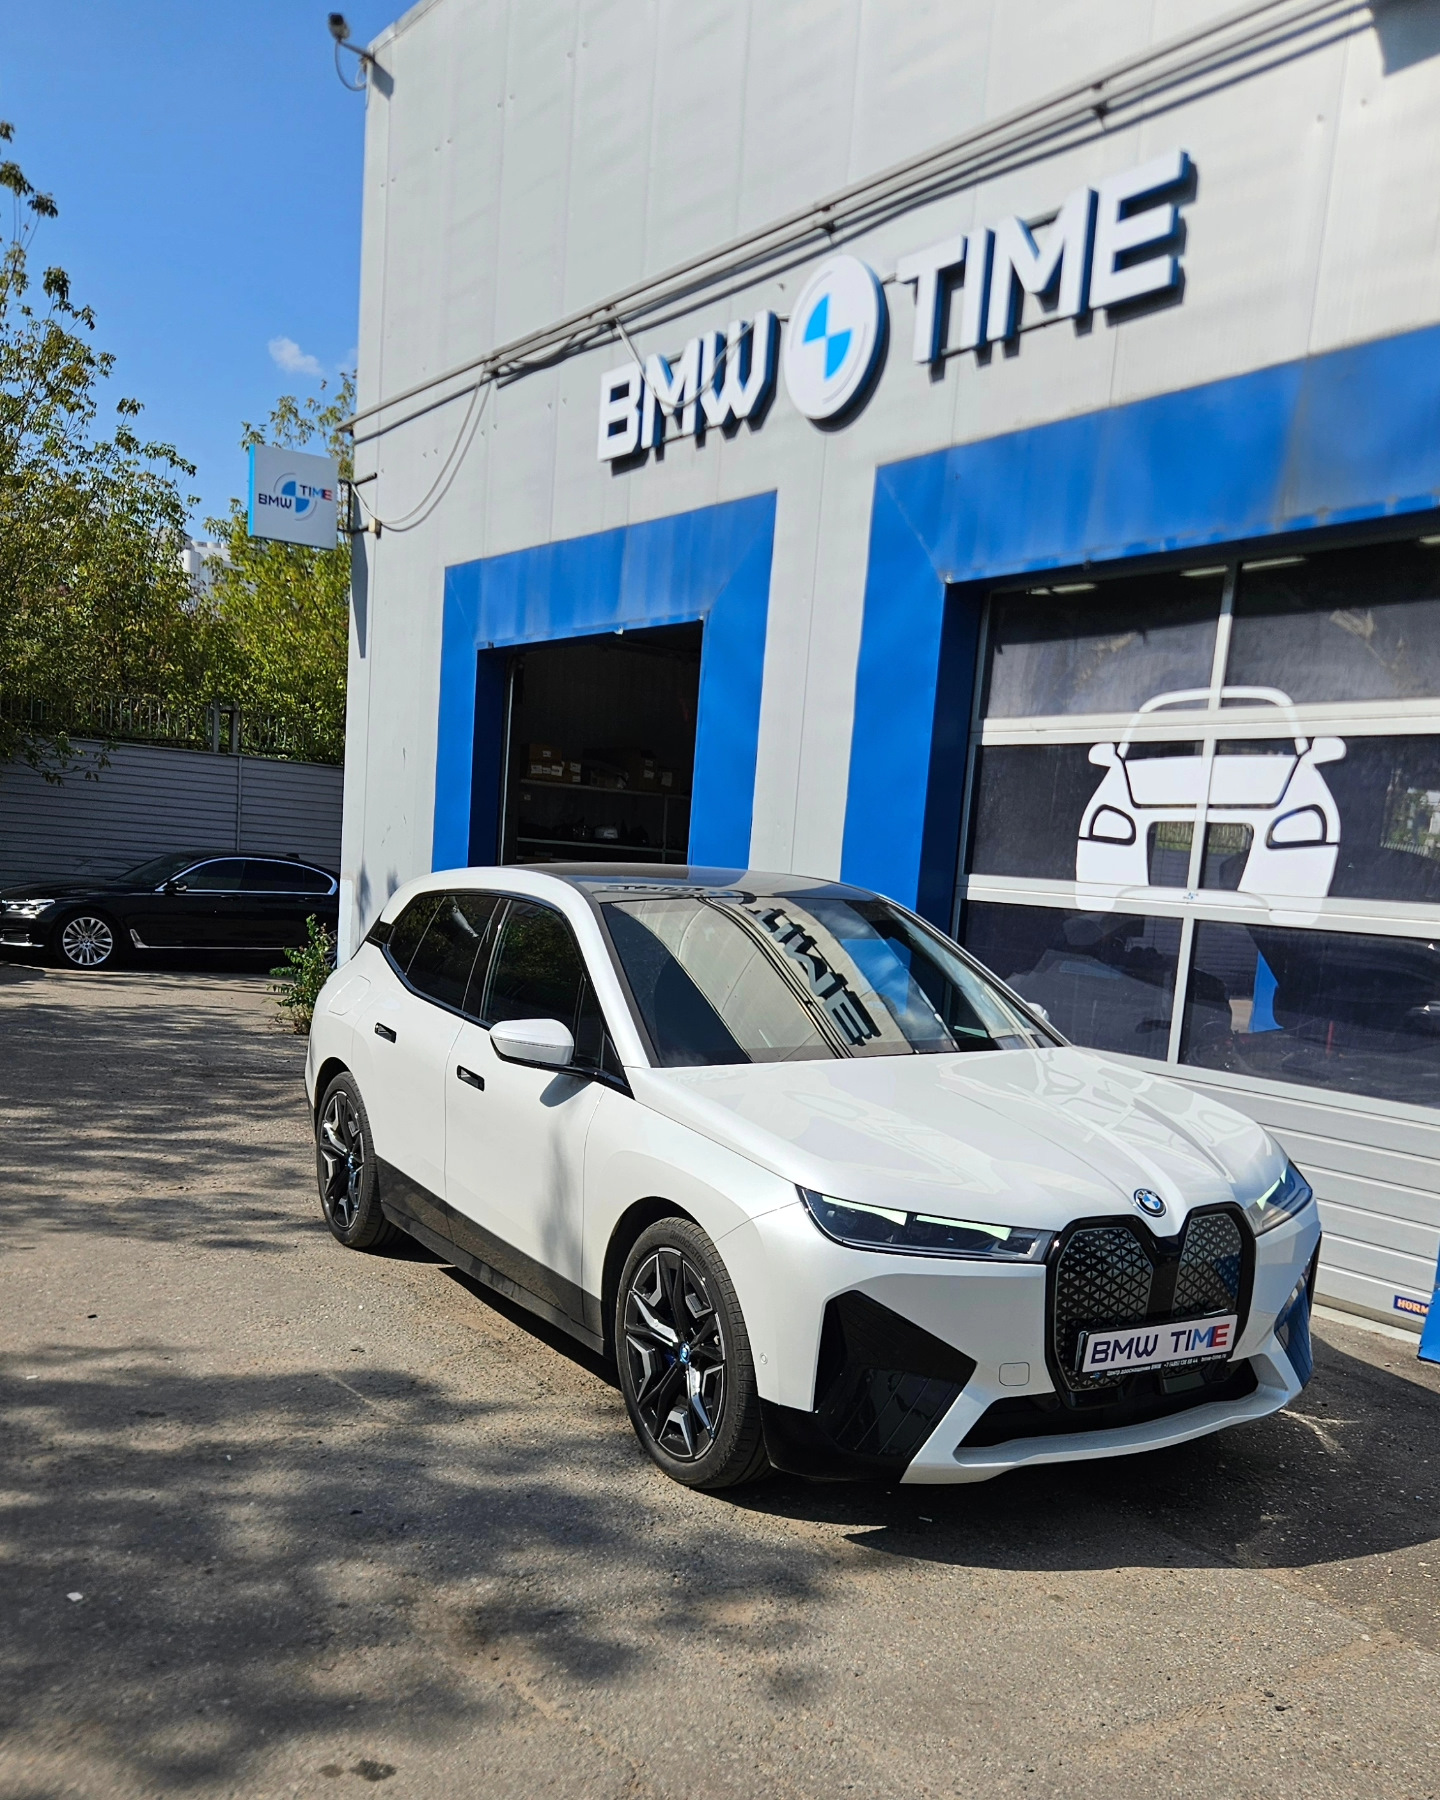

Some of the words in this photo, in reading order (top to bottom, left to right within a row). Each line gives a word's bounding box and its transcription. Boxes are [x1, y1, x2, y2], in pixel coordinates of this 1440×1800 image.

[597, 309, 779, 461] BMW
[897, 149, 1191, 363] TIME
[258, 493, 292, 509] BMW
[299, 484, 333, 501] TIME
[669, 1230, 709, 1270] BRIDGESTONE
[1090, 1334, 1159, 1364] BMW
[1170, 1323, 1230, 1353] TIME
